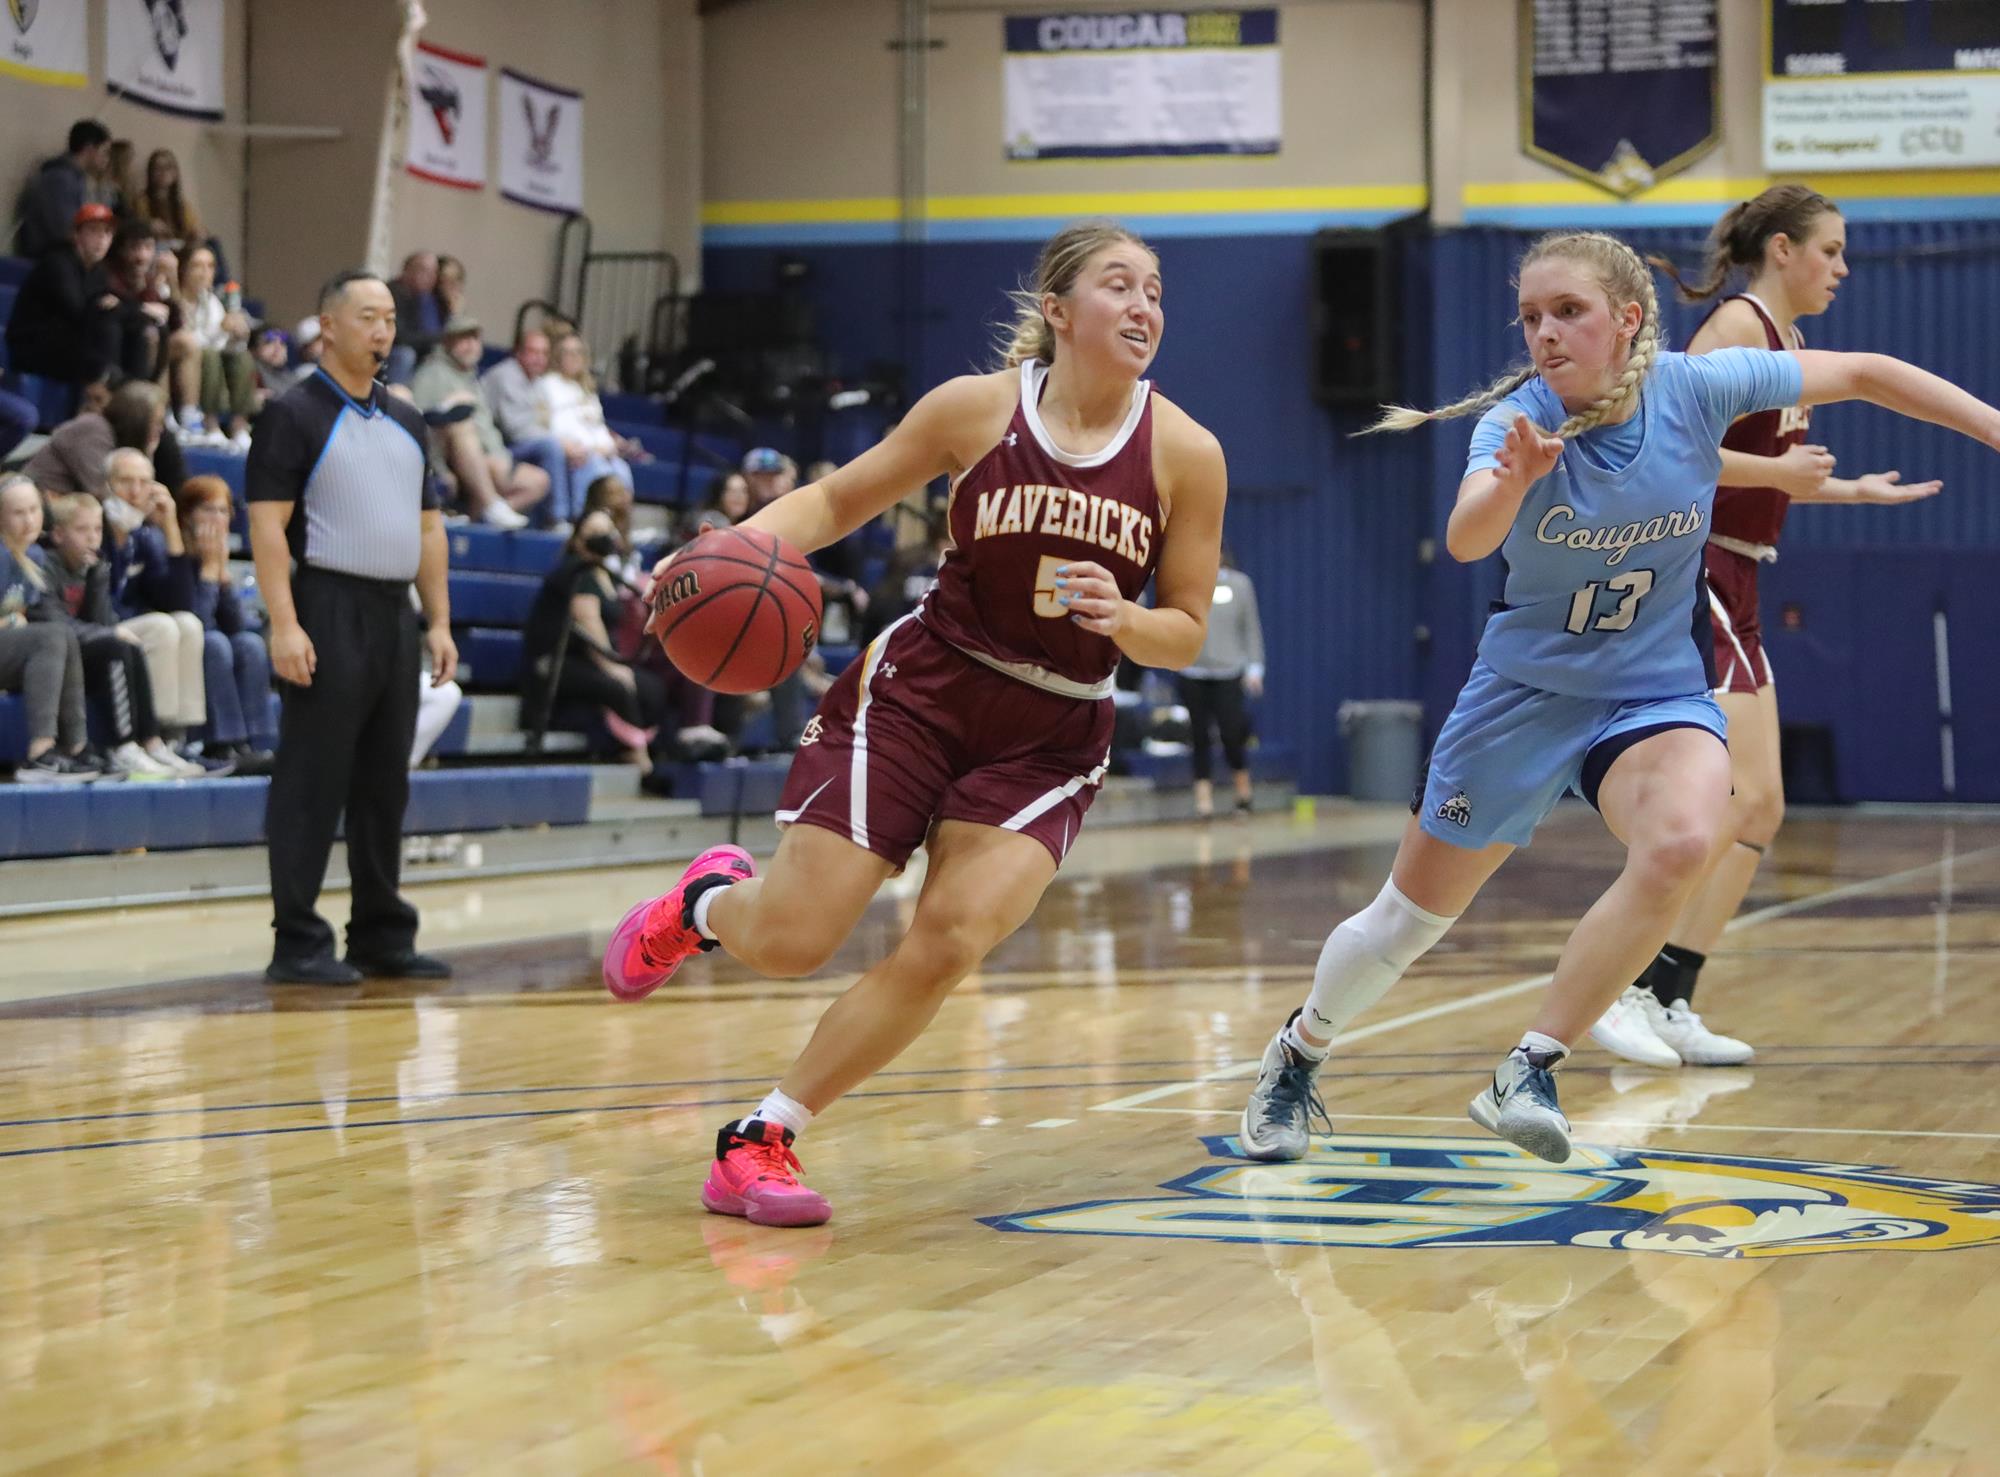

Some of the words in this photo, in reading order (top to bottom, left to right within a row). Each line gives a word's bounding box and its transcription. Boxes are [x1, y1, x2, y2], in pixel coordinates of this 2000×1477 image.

[1038, 13, 1187, 49] COUGAR
[974, 484, 1153, 568] MAVERICKS
[1536, 501, 1705, 566] Cougars
[1033, 554, 1078, 618] 5
[1564, 568, 1656, 635] 13
[1436, 803, 1471, 828] CCU
